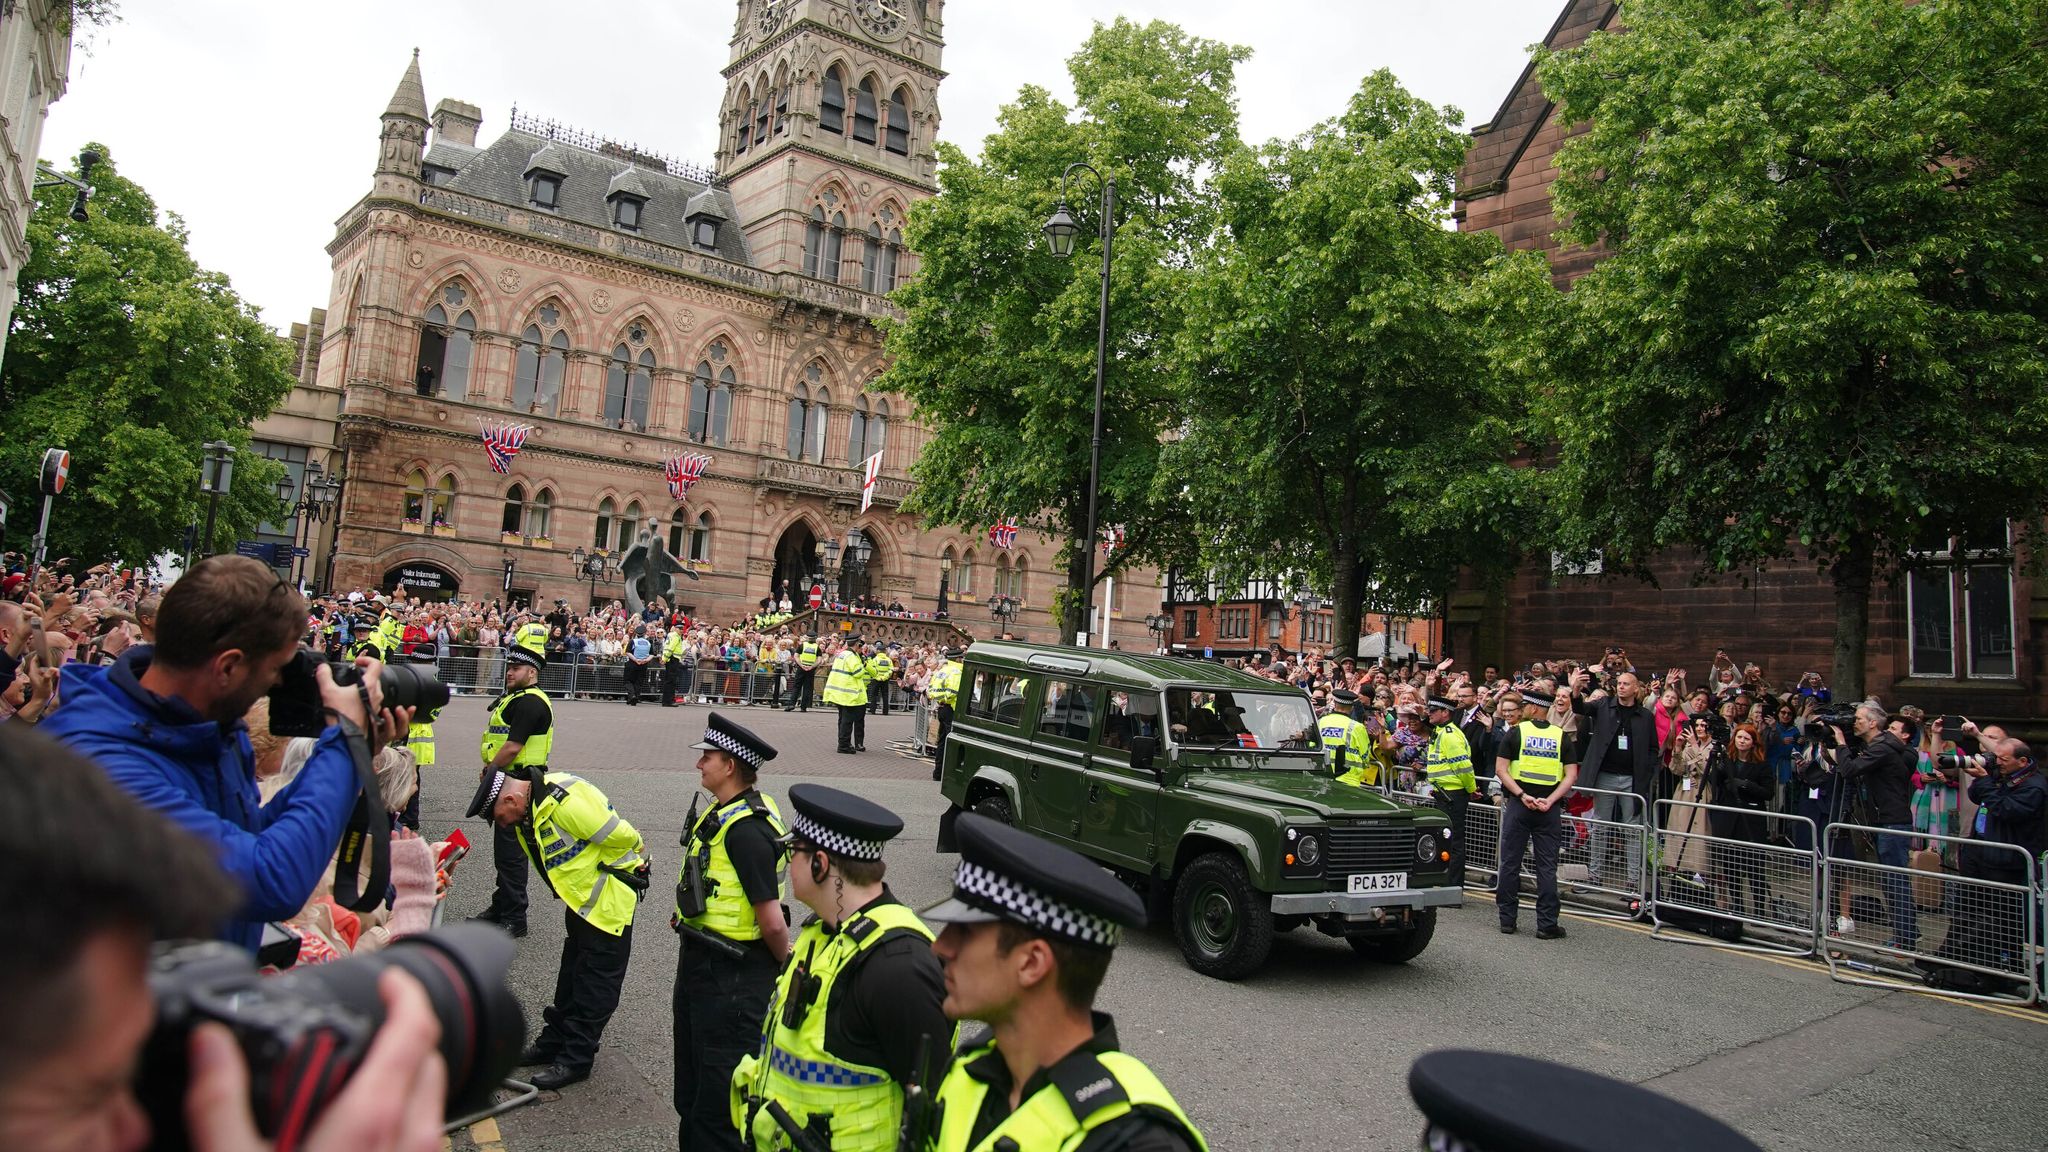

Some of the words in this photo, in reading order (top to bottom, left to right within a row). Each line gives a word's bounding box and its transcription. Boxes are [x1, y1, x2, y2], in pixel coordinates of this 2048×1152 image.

[402, 568, 415, 577] Visitor
[416, 570, 441, 580] Information
[400, 577, 416, 585] Centre
[429, 580, 441, 588] Office
[1526, 736, 1557, 750] POLICE
[545, 839, 566, 855] POLICE
[1353, 876, 1378, 890] PCA
[1380, 874, 1402, 889] 32Y
